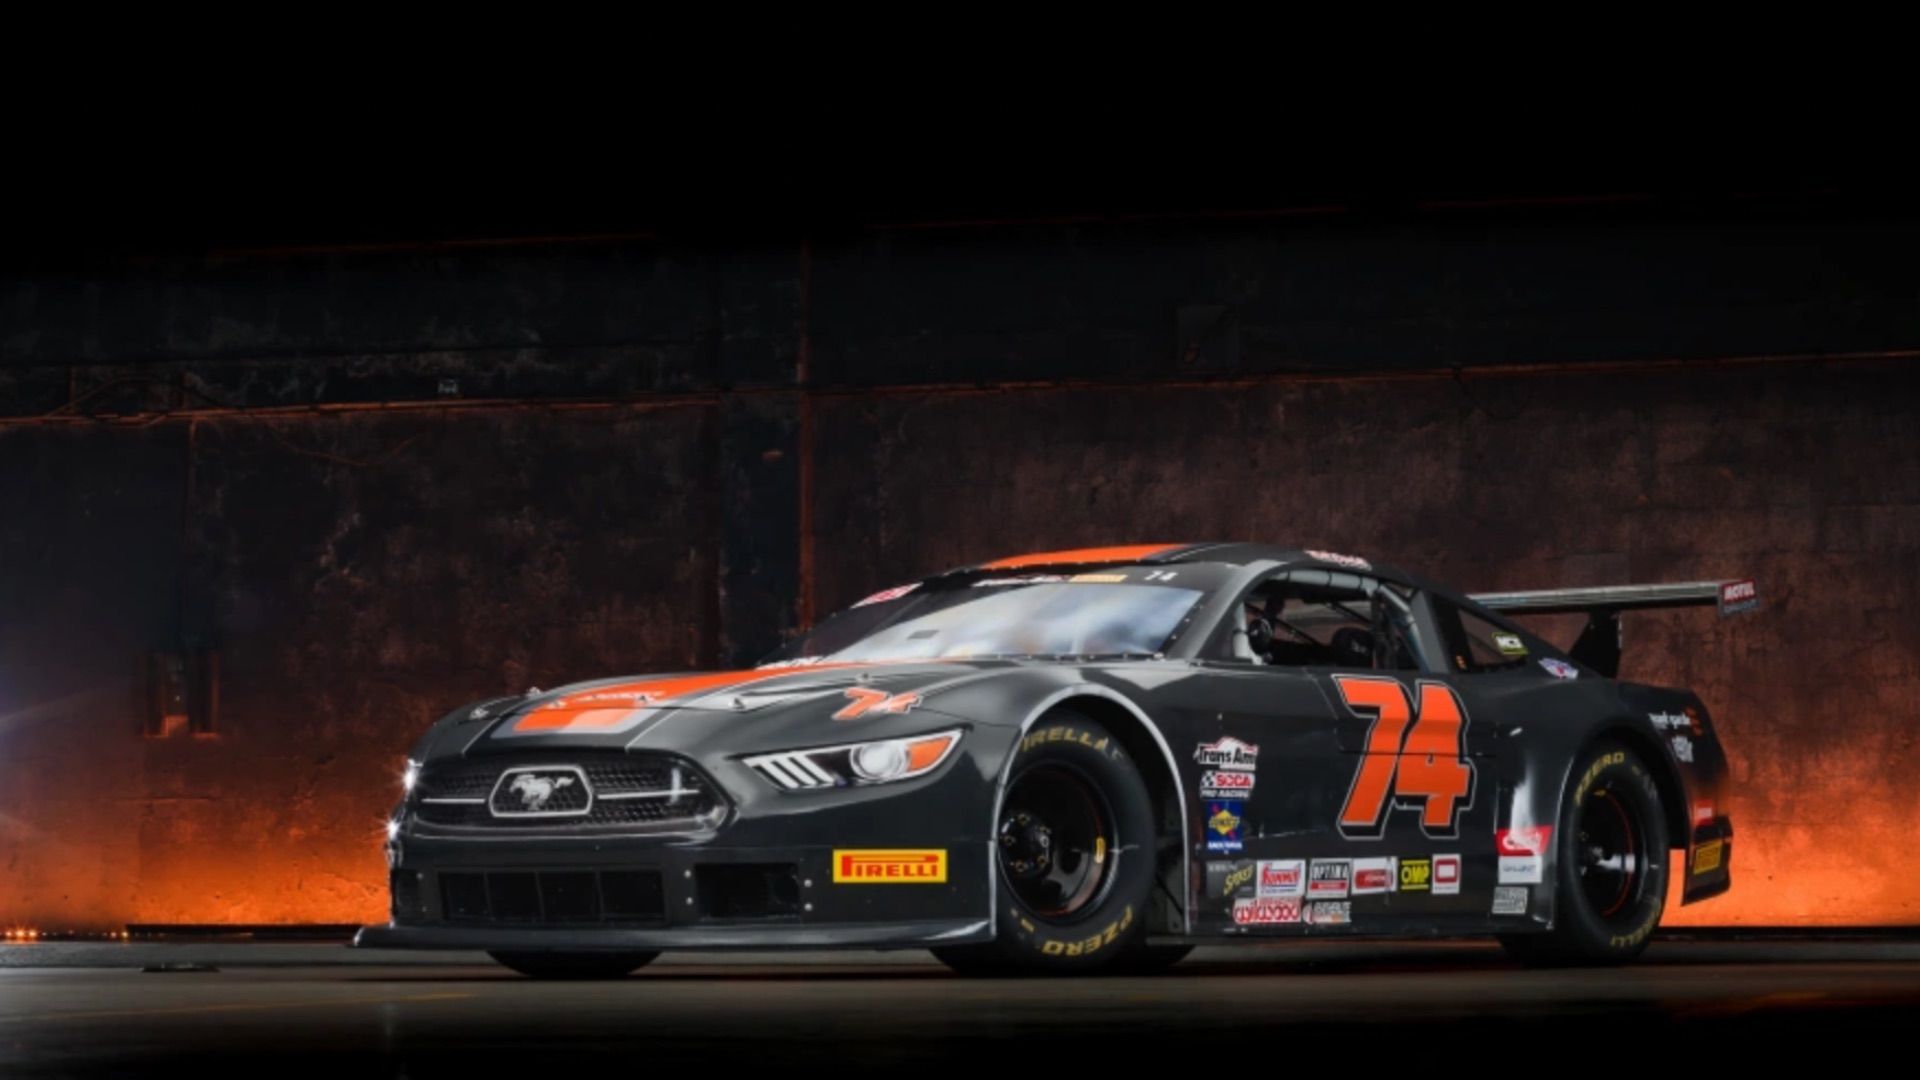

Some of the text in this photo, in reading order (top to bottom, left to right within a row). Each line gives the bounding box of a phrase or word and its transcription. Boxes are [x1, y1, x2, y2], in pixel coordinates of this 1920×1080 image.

[831, 686, 923, 721] 74
[1021, 726, 1109, 752] IRELLI
[1331, 674, 1477, 840] 74
[1216, 774, 1251, 787] SCCA
[841, 855, 939, 877] PIRELLI
[1401, 865, 1429, 884] OMP
